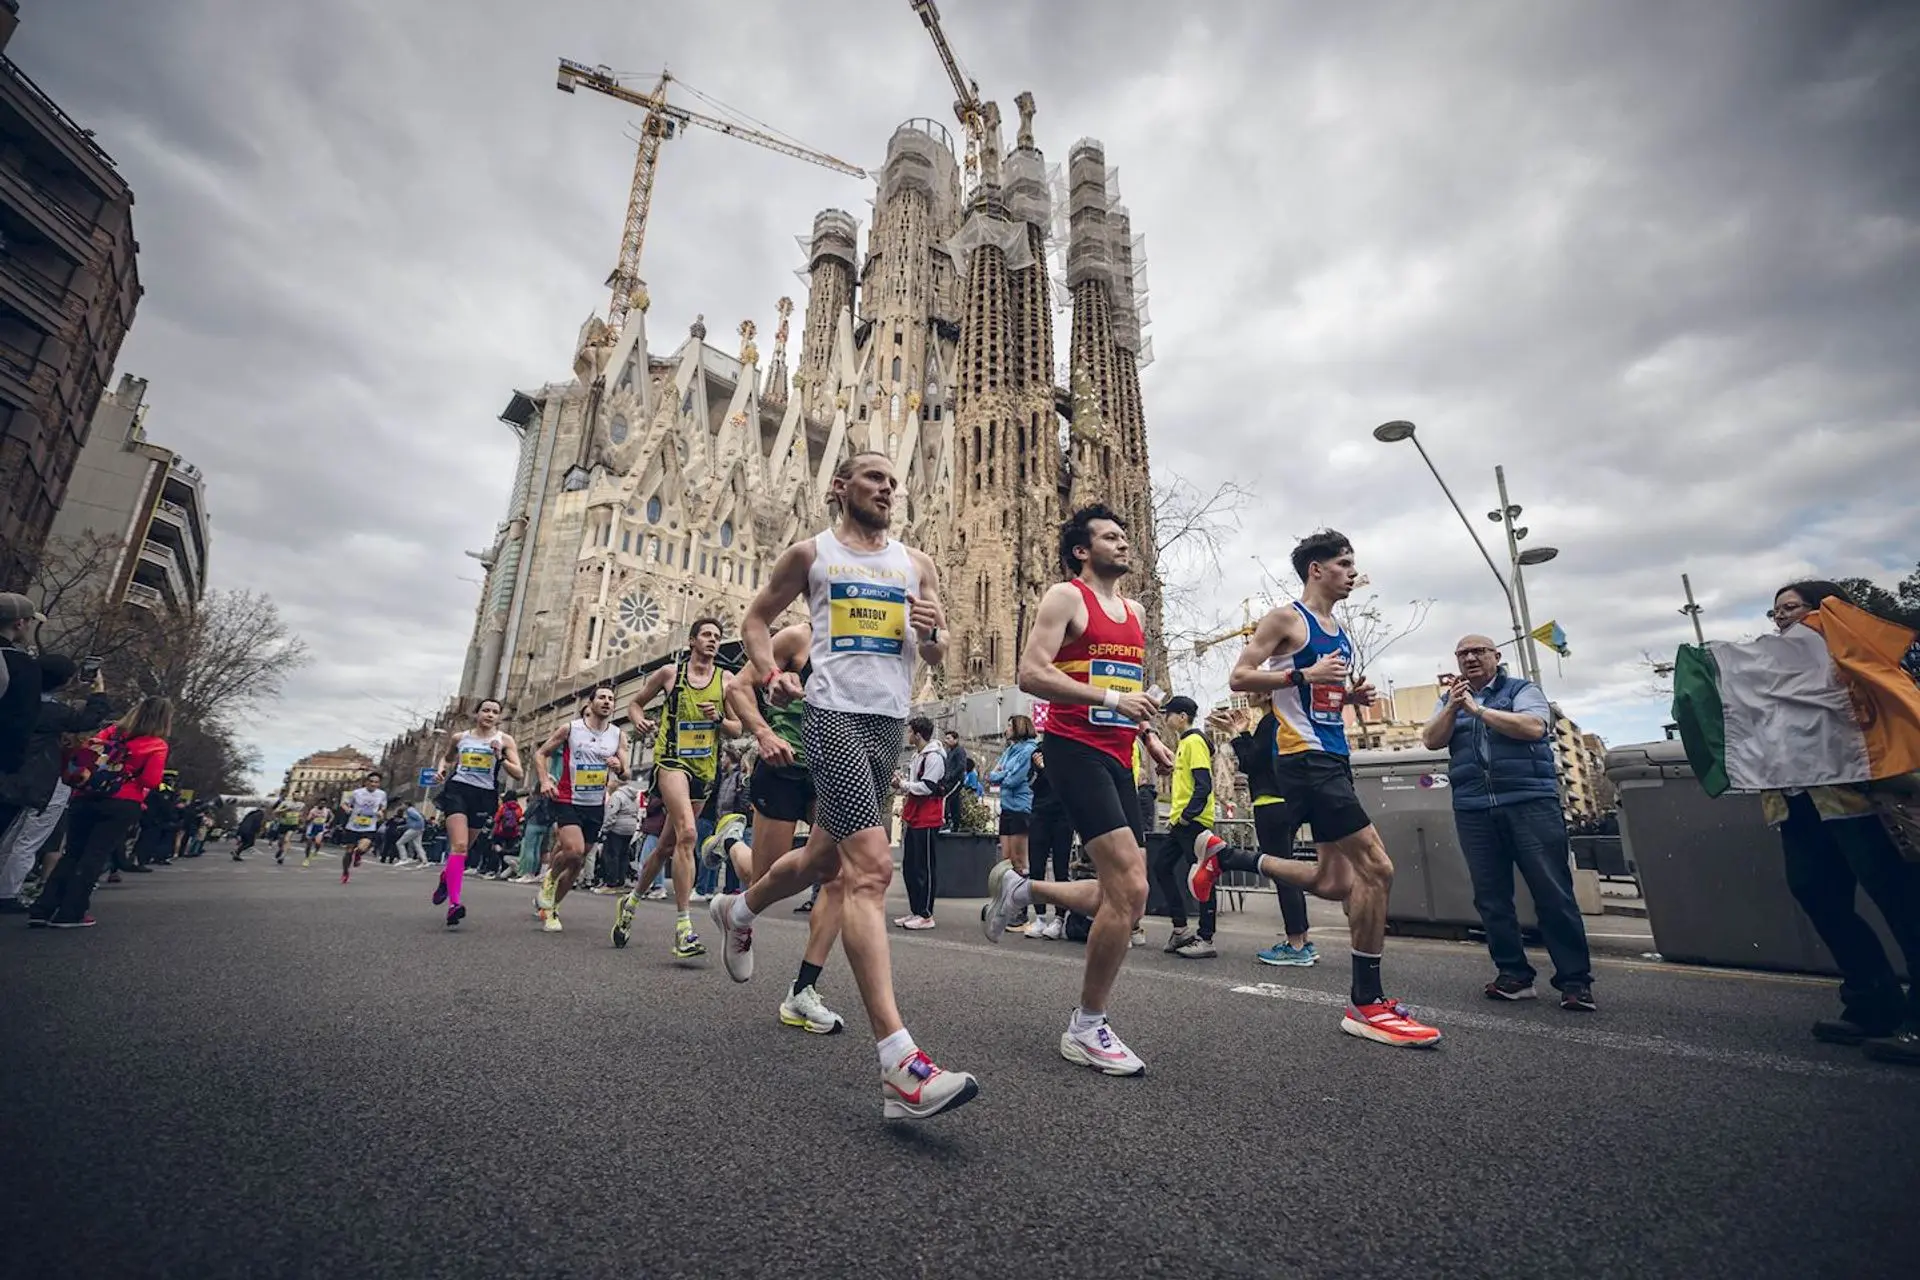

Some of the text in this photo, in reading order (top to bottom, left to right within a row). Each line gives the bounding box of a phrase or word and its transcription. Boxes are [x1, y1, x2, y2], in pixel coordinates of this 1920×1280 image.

[827, 565, 907, 581] BOSTON
[861, 588, 891, 598] ZURICH
[849, 607, 887, 621] ANATOLY
